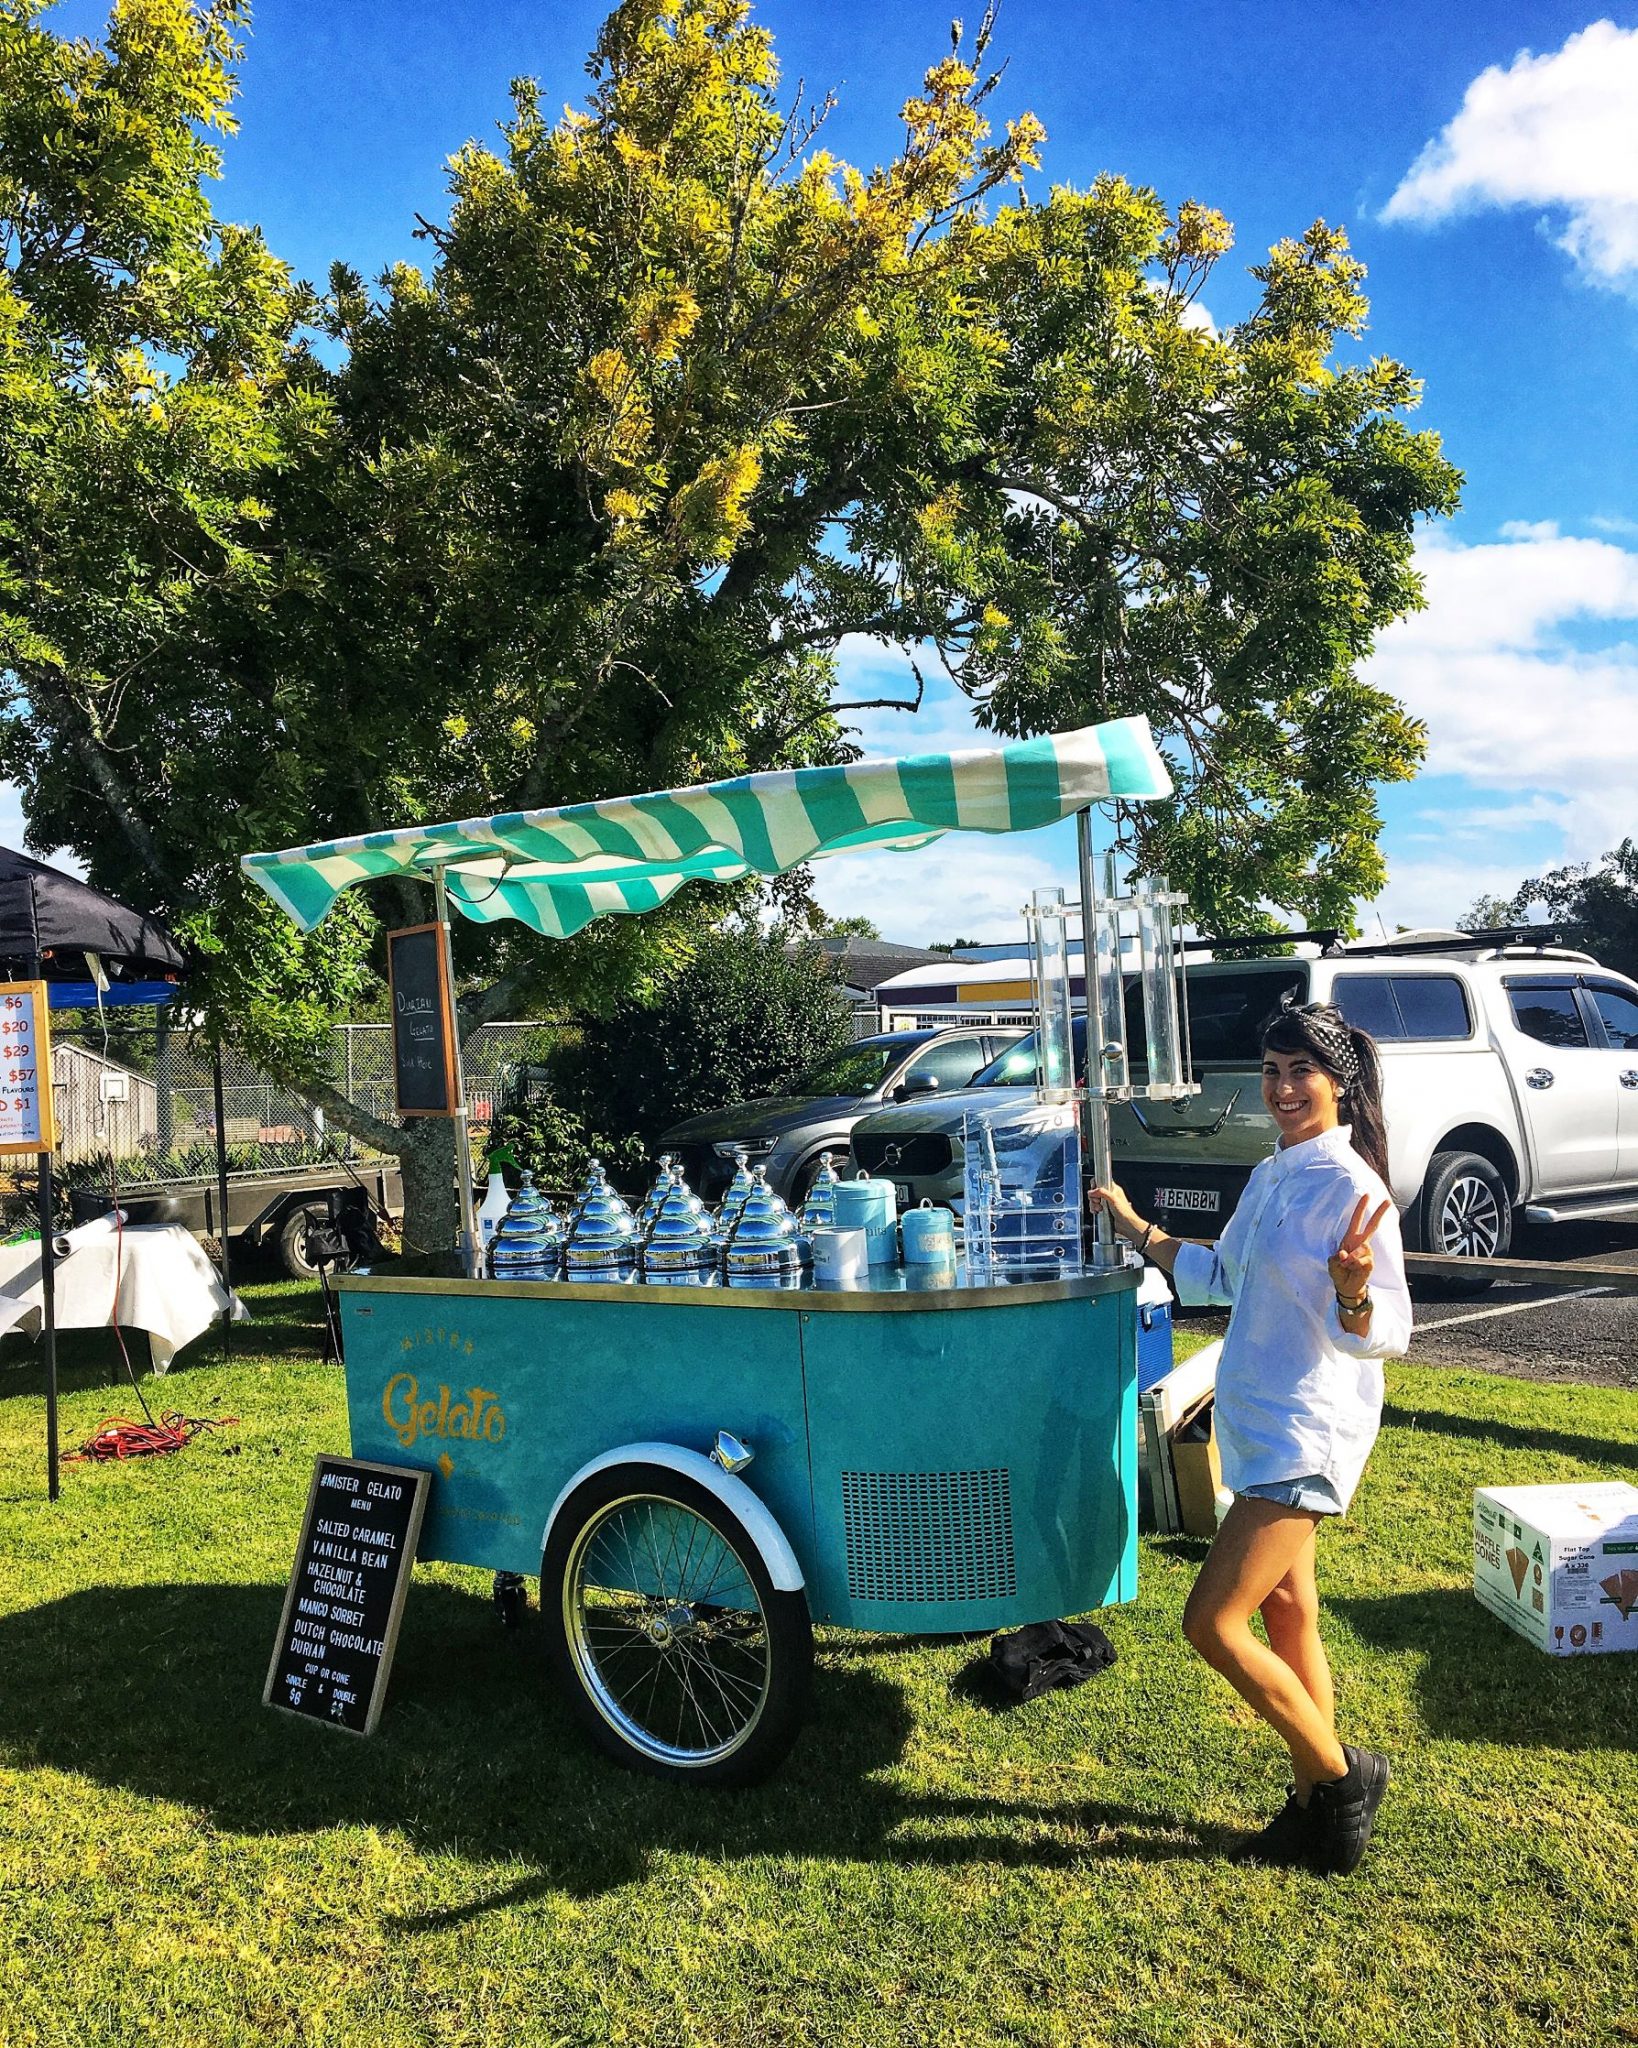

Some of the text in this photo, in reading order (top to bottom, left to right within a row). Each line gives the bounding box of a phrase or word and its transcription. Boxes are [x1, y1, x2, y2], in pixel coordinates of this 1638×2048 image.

[5, 996, 23, 1011] $6
[2, 1020, 28, 1035] $20
[4, 1044, 29, 1059] $29
[9, 1069, 35, 1084] $57
[14, 1097, 30, 1112] $1
[382, 1372, 506, 1448] Gelato
[320, 1473, 402, 1500] #MISTER GELATO
[350, 1498, 372, 1512] MENU
[317, 1519, 397, 1549] SALTED CARAMEL
[1475, 1528, 1500, 1556] WAFFLE
[313, 1540, 389, 1569] VANILLA BEAN
[1475, 1542, 1500, 1570] CONES
[307, 1561, 363, 1586] HAZELNUT &
[313, 1579, 367, 1604] CHOCOLATE
[298, 1597, 365, 1628] MANGO SORBET
[290, 1637, 326, 1660] DURIAN
[294, 1619, 384, 1657] DUTCH CHOCOLATE
[305, 1662, 350, 1685] CUP OR CONE
[332, 1688, 357, 1705] DOUBLE
